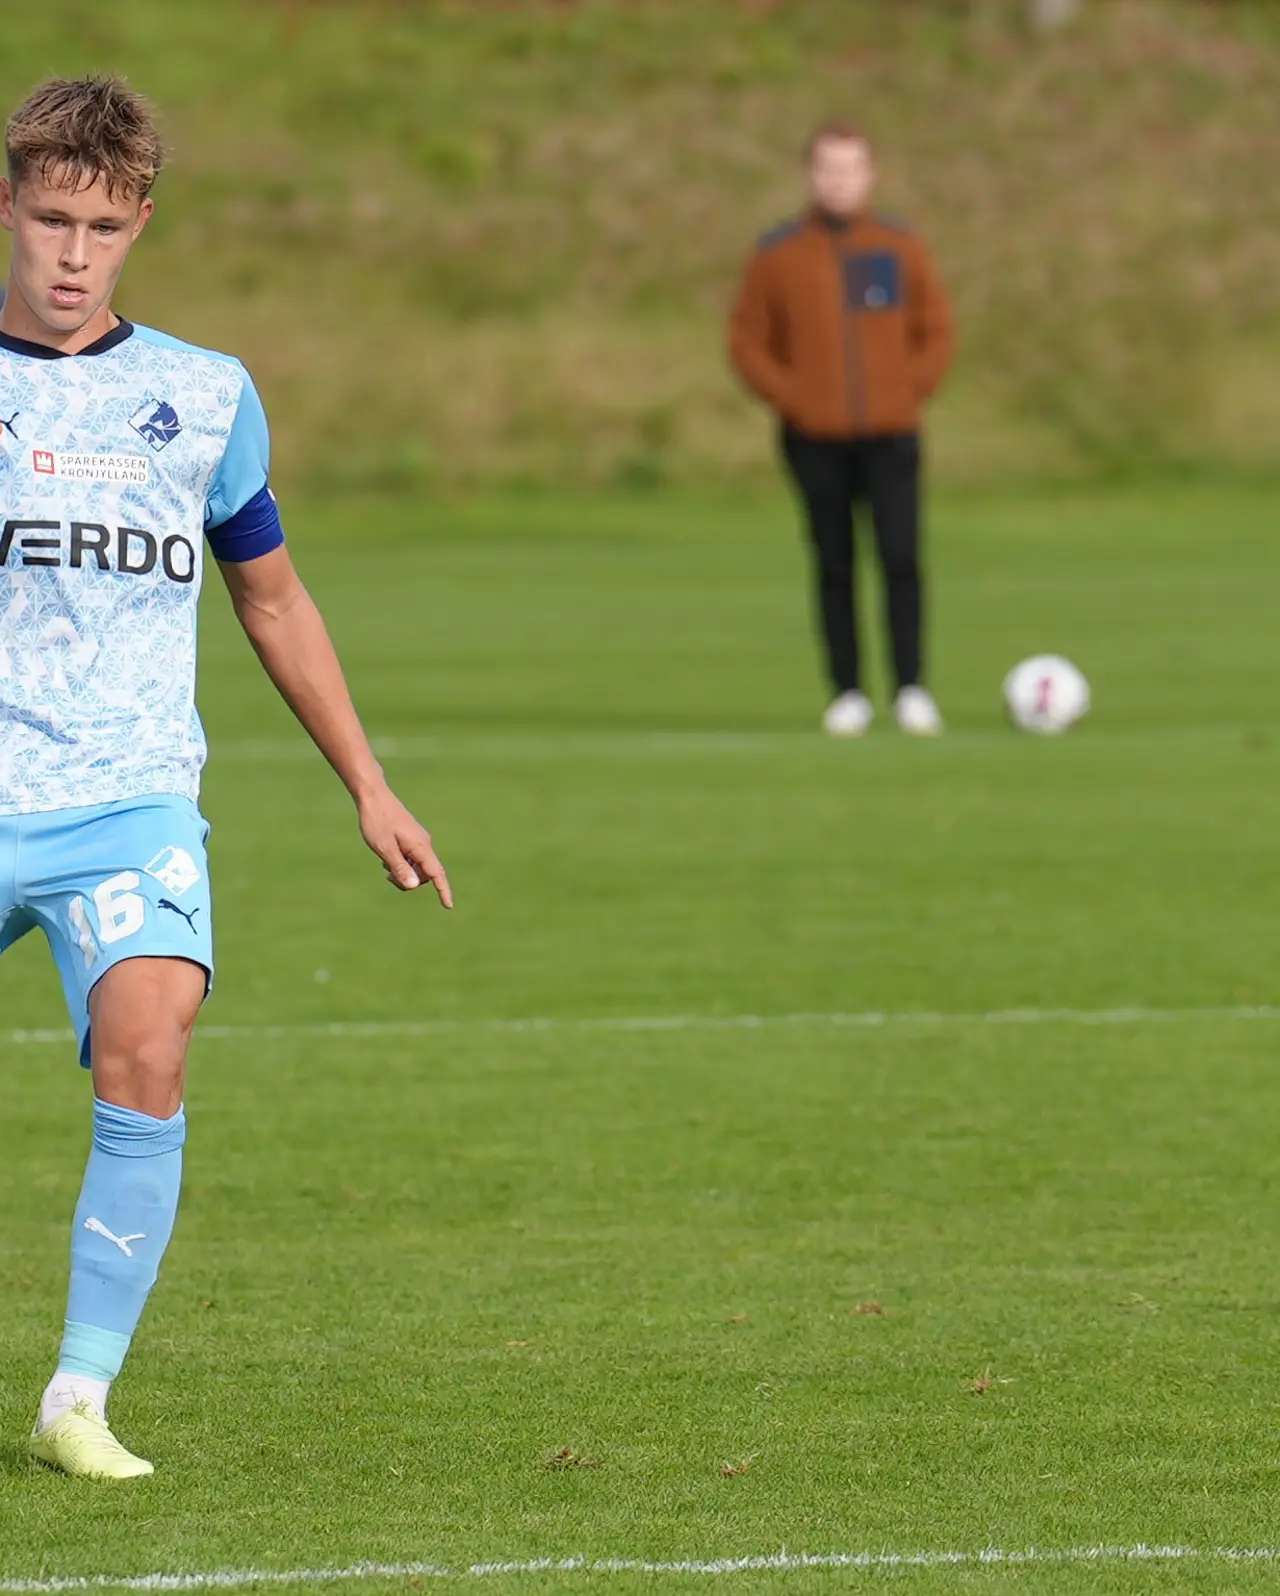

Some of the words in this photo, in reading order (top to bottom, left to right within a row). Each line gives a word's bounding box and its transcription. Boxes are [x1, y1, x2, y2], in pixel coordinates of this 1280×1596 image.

[59, 455, 147, 469] SPAREKASSEN
[60, 467, 147, 482] KRONJYLLAND
[68, 870, 145, 970] 16
